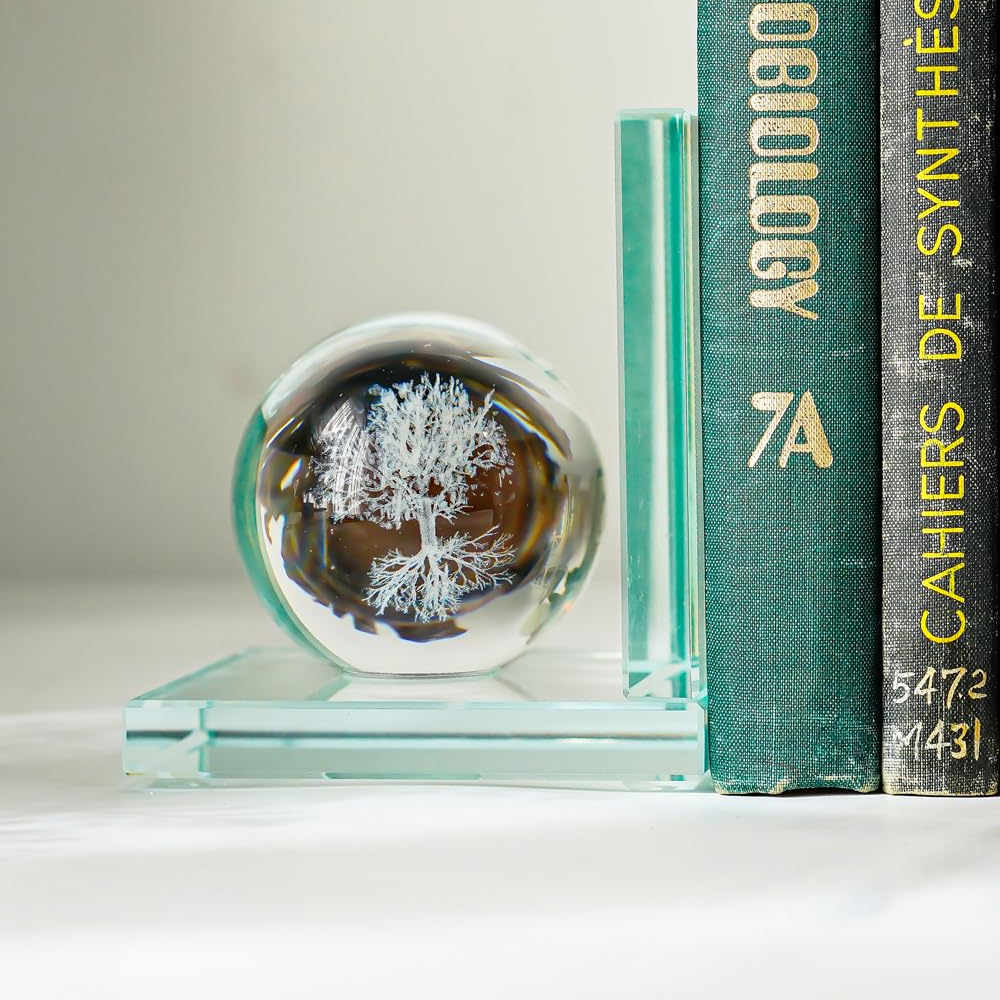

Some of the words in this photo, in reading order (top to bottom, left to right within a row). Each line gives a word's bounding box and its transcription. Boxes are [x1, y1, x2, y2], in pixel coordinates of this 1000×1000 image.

[918, 293, 963, 361] DE
[750, 391, 833, 468] 7A
[919, 401, 966, 644] CAHIERS
[892, 666, 988, 710] 547.2
[891, 716, 981, 761] M431
